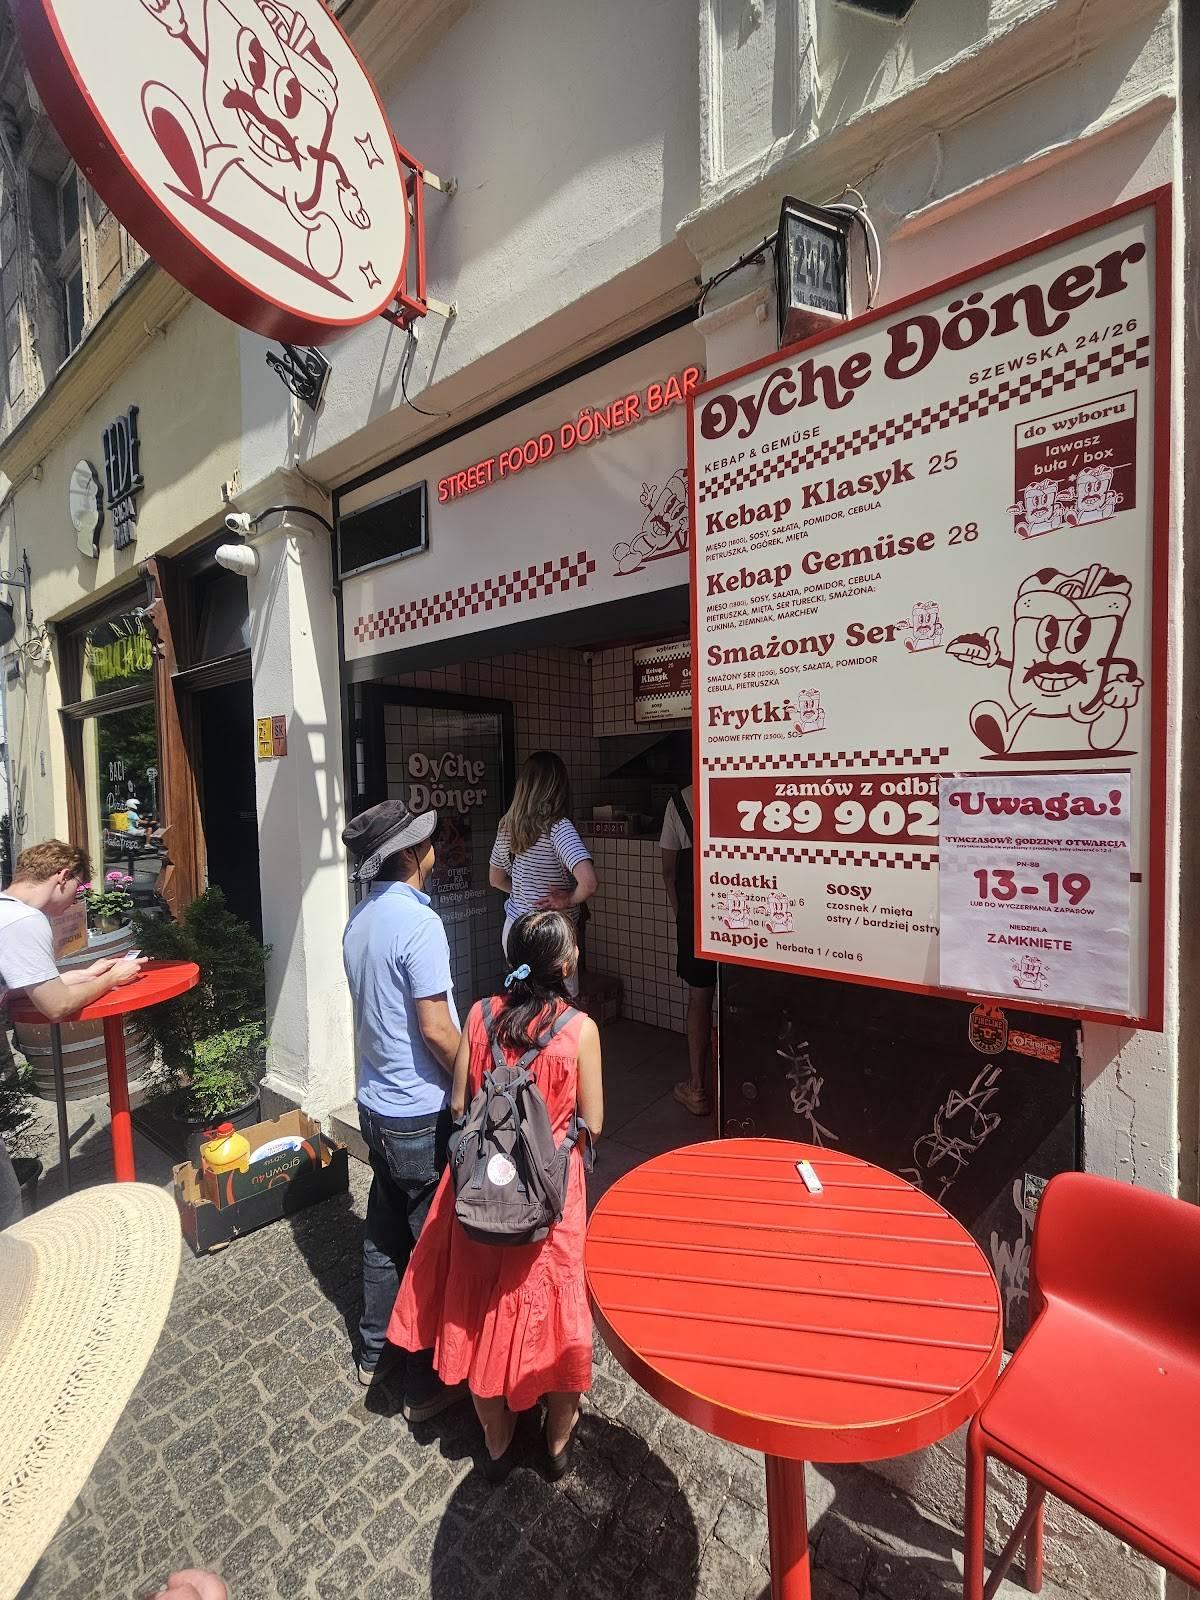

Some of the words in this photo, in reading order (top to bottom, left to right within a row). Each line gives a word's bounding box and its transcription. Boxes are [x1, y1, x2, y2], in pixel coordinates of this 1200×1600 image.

[700, 352, 872, 440] Oyche
[884, 242, 1146, 381] Döner
[968, 341, 1068, 385] SZEWSKA
[1075, 317, 1138, 350] 24/26
[437, 458, 495, 504] STREET
[499, 433, 555, 477] FOOD
[560, 394, 641, 450] DÖNER
[647, 367, 700, 413] BAR
[1024, 426, 1046, 440] do
[1051, 403, 1127, 430] wyboru
[704, 452, 745, 474] KEBAP
[749, 448, 757, 459] &
[761, 426, 821, 454] GEMÜSE
[1045, 434, 1101, 457] lawasz
[1034, 459, 1067, 476] buła
[1071, 454, 1080, 467] /
[1083, 447, 1114, 464] box
[705, 496, 792, 536] Kebap
[801, 458, 916, 510] Klasyk
[928, 450, 958, 475] 25
[705, 541, 727, 553] MIĘSO
[749, 529, 771, 541] SOSY,
[771, 521, 801, 536] SAŁATA,
[803, 509, 846, 528] POMIDOR,
[847, 500, 882, 516] CEBULA
[705, 546, 748, 562] PIETRUSZKA,
[750, 536, 784, 552] OGÓREK,
[786, 530, 809, 544] MIĘTA
[706, 560, 792, 597] Kebap
[801, 531, 936, 575] Gemüse
[948, 522, 979, 546] 28
[706, 602, 728, 613] MIĘSO
[750, 593, 771, 605] SOSY,
[772, 587, 801, 601] SAŁATA,
[803, 579, 846, 597] POMIDOR,
[848, 572, 882, 587] CEBULA
[706, 609, 749, 623] PIETRUSZKA,
[751, 604, 774, 616] MIĘTA,
[776, 599, 790, 610] SER
[791, 594, 827, 608] TURECKI,
[828, 586, 876, 604] SMAŻONA:
[706, 622, 737, 633] CUKINIA,
[738, 615, 775, 628] ZIEMNIAK,
[777, 606, 819, 621] MARCHEW
[707, 631, 836, 668] Smażony
[846, 622, 897, 648] Ser
[641, 672, 668, 684] Klasyk
[707, 671, 742, 684] SMAŻONY
[743, 670, 756, 679] SER
[779, 665, 801, 675] SOSY,
[802, 661, 834, 672] SAŁATA,
[836, 655, 878, 668] POMIDOR
[707, 683, 735, 693] CEBULA,
[736, 678, 780, 690] PIETRUSZKA
[708, 699, 793, 730] Frytki
[708, 734, 741, 744] DOMOWE
[741, 733, 762, 742] FRYTY
[408, 752, 485, 785] Oyche
[408, 783, 487, 814] Döner
[775, 779, 854, 797] zamów
[860, 782, 873, 796] z
[880, 777, 939, 797] odbi
[736, 800, 823, 834] 789
[834, 800, 940, 837] 902
[948, 789, 1122, 821] Uwaga!
[709, 872, 778, 890] dodatki
[826, 883, 873, 900] sosy
[974, 869, 1091, 906] 13-19
[798, 898, 805, 907] 6
[826, 901, 869, 913] czosnek
[871, 904, 877, 914] /
[880, 906, 913, 919] mięta
[997, 902, 1052, 913] WYCZERPANIA
[826, 914, 852, 927] ostry
[854, 916, 860, 926] /
[862, 916, 909, 933] bardziej
[912, 922, 940, 936] ostry
[1009, 923, 1048, 933] NIEDZIELA
[710, 930, 769, 949] napoje
[776, 941, 814, 955] herbata
[816, 947, 822, 956] 1
[824, 947, 830, 957] /
[832, 948, 855, 960] cola
[856, 952, 863, 962] 6
[987, 933, 1073, 951] ZAMKNIĘTE
[251, 1156, 302, 1185] grown4u
